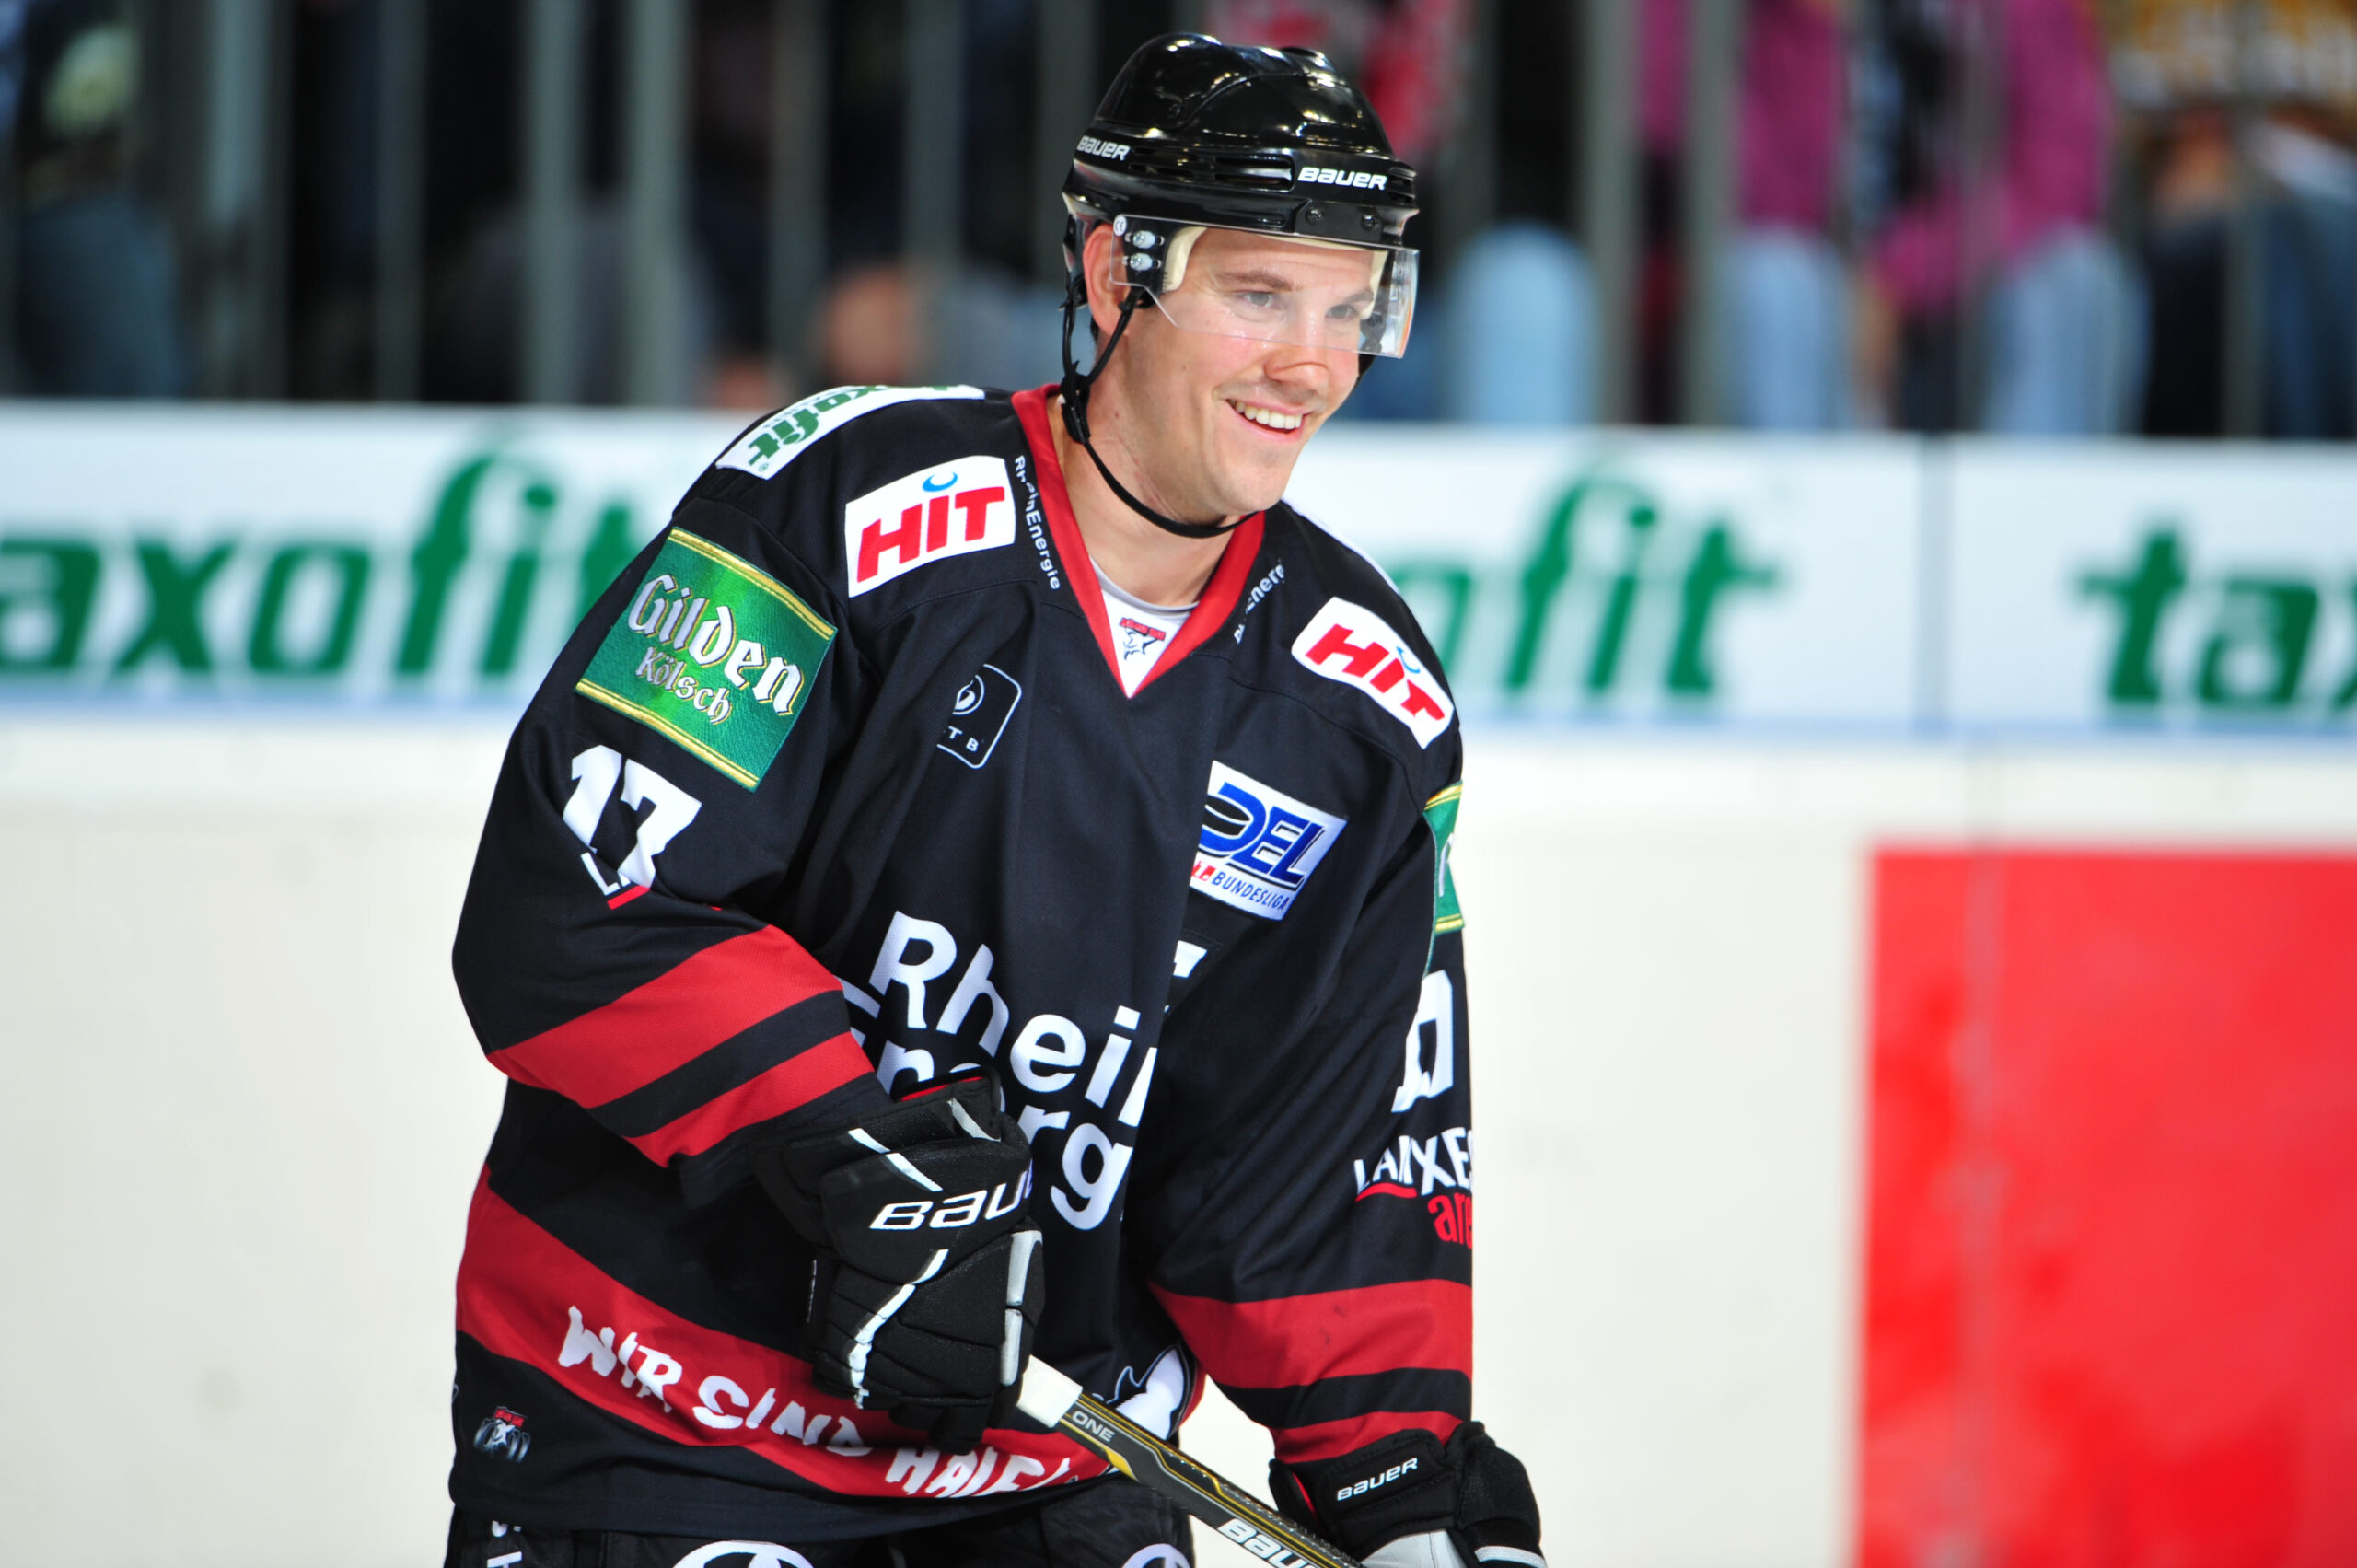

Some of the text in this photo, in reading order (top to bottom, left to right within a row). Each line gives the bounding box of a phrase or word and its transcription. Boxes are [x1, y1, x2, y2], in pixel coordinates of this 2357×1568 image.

[857, 486, 1006, 584] HIT
[628, 573, 806, 716] Gilden
[635, 646, 734, 725] Kölsch
[1305, 623, 1446, 721] HIT
[563, 745, 702, 890] 17
[1198, 781, 1324, 891] DEL
[1212, 871, 1291, 911] BUNDESLIGA
[558, 1305, 682, 1413] WIR
[692, 1375, 873, 1457] SIND
[1072, 1409, 1115, 1443] ONE
